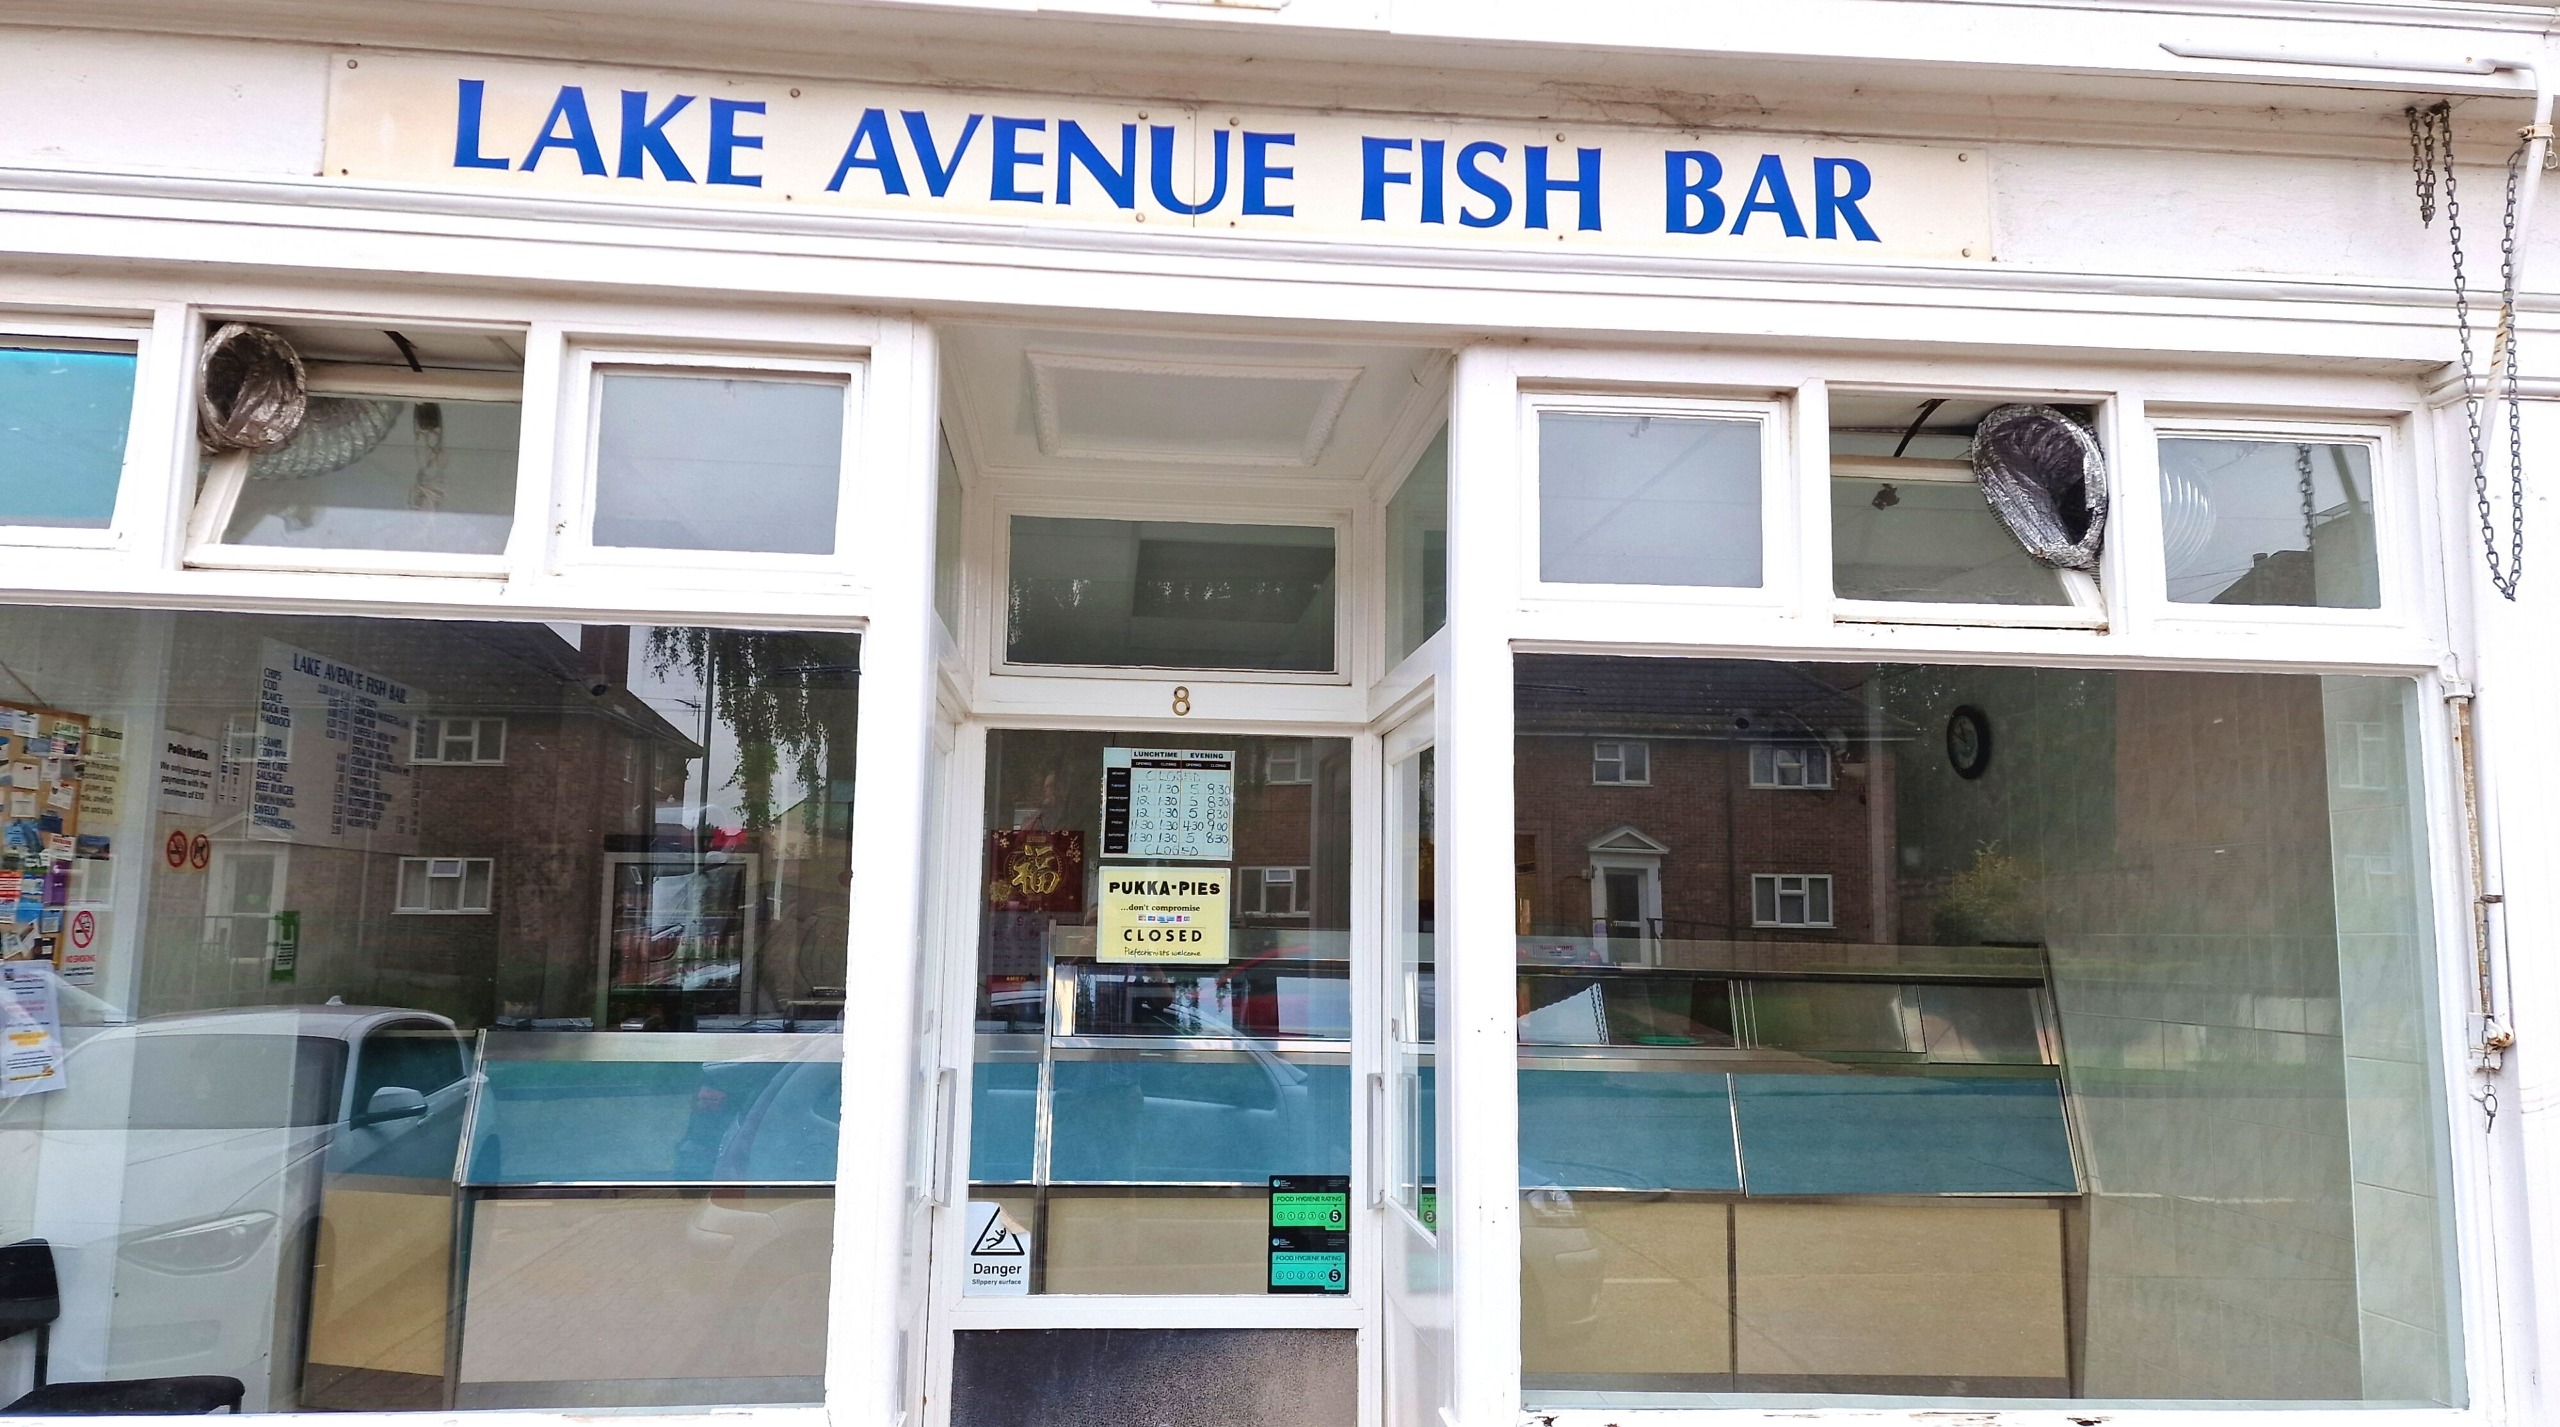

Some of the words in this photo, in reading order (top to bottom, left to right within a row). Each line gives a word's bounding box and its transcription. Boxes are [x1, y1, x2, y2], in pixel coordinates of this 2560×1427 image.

[453, 79, 767, 188] LAKE
[825, 108, 1296, 218] AVENUE
[1360, 135, 1602, 231] FISH
[1665, 150, 1882, 243] BAR
[264, 668, 283, 681] CHIPS
[293, 653, 322, 677] LAKE
[323, 663, 363, 690] AVENUE
[366, 676, 387, 698] FISH
[389, 684, 407, 704] BAR
[263, 679, 278, 691] COD
[1172, 686, 1190, 716] 8
[260, 713, 291, 728] HADDOCK
[168, 743, 186, 756] Polite
[187, 747, 208, 760] Notice
[160, 761, 169, 770] We
[171, 765, 181, 774] only
[1146, 771, 1201, 781] CLOSED
[1190, 784, 1199, 795] 5
[1136, 808, 1149, 817] 12
[1189, 807, 1198, 818] 5
[1186, 832, 1195, 843] 5
[1145, 844, 1199, 856] CLOSED
[1011, 843, 1061, 895] 福
[1124, 929, 1203, 942] CLOSED
[1171, 949, 1202, 957] welcome
[1332, 1211, 1339, 1221] 5
[973, 1263, 1022, 1277] Danger
[1331, 1271, 1338, 1281] 5
